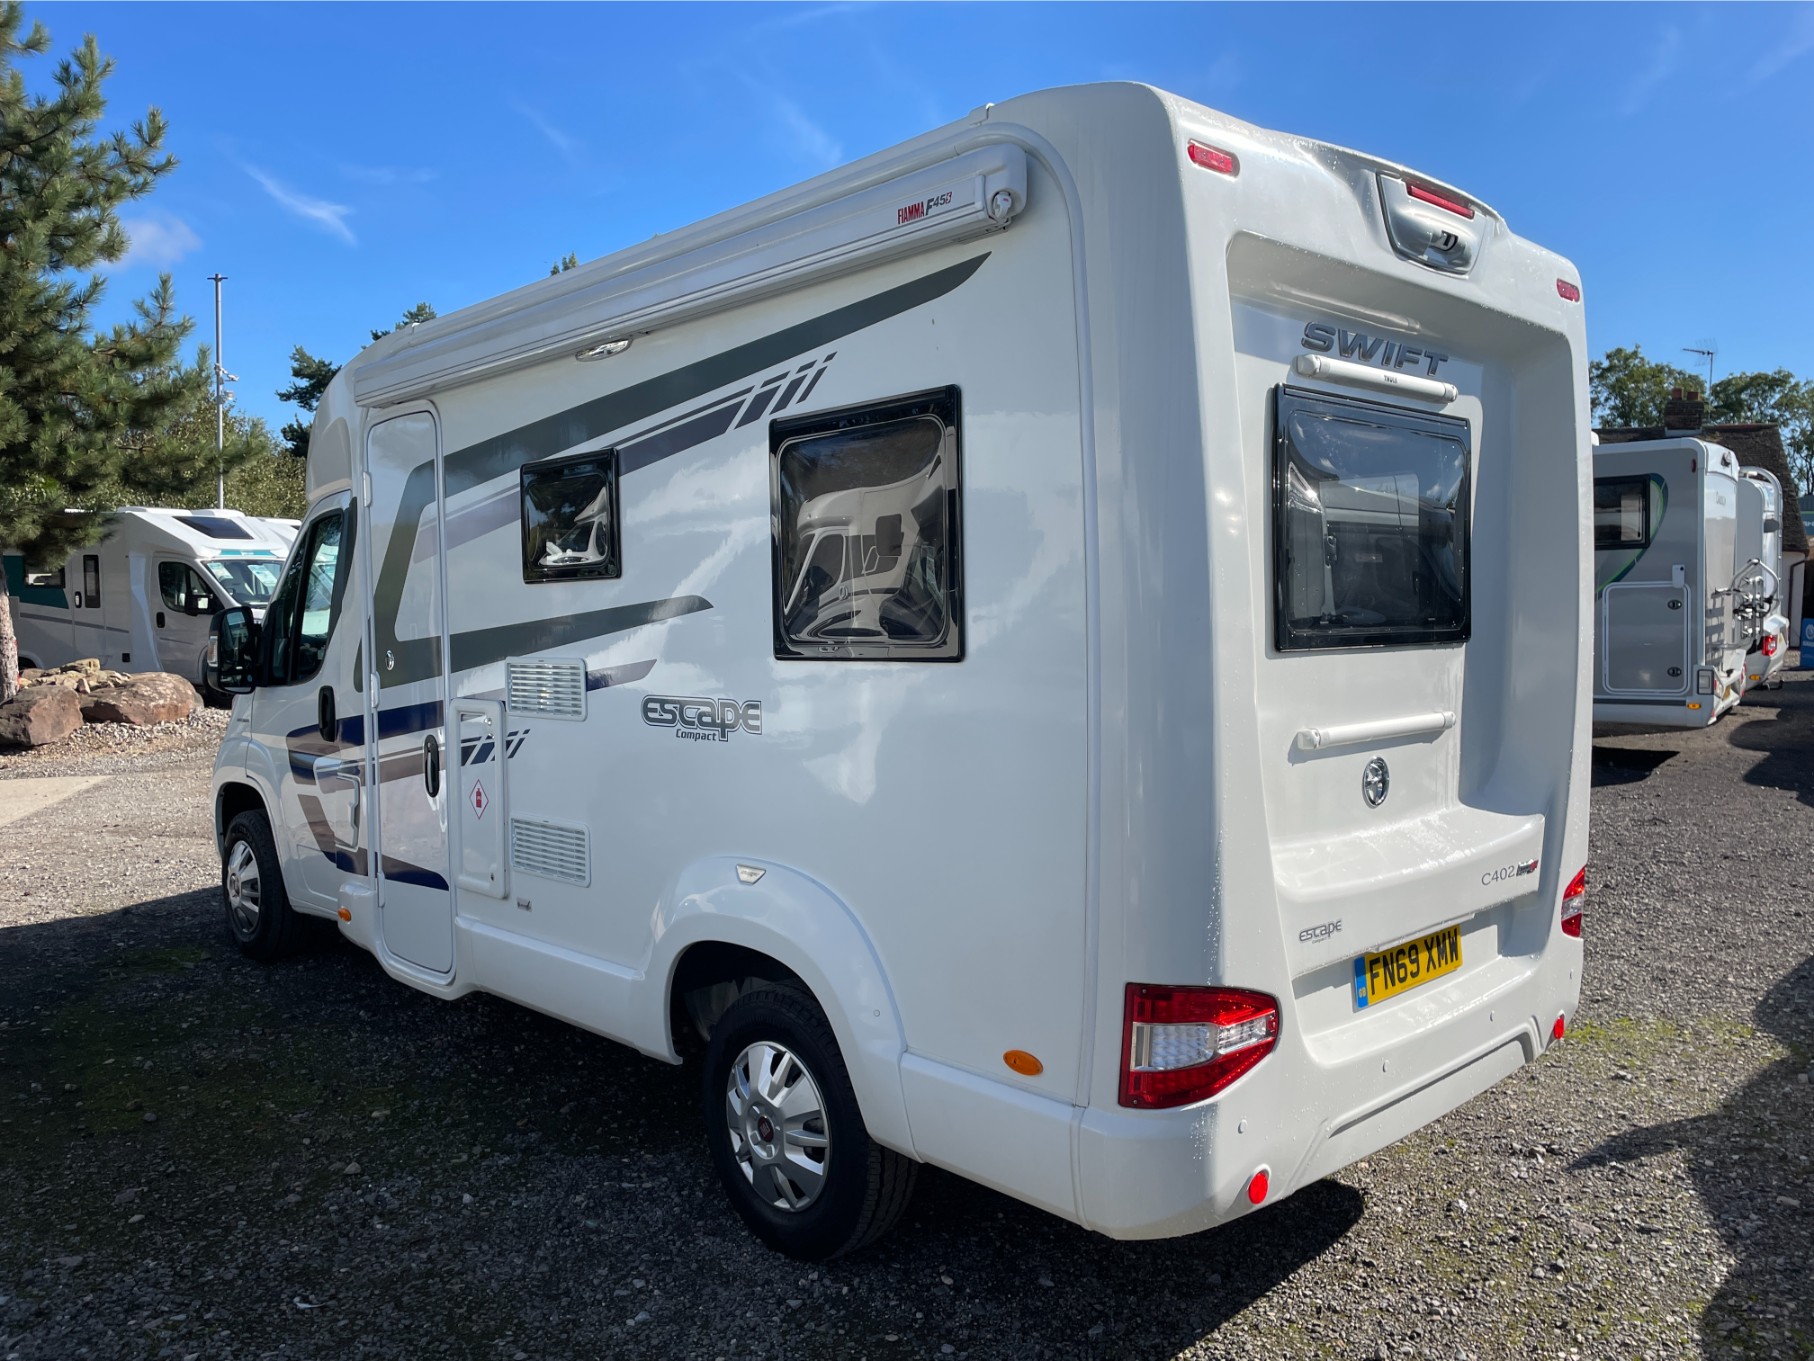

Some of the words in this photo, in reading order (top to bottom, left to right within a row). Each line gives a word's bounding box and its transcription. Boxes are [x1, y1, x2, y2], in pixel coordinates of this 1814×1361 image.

[898, 201, 925, 225] FIAMMA
[1301, 321, 1449, 377] SWIFT
[676, 728, 717, 742] Compact
[1481, 865, 1515, 886] C402
[1369, 943, 1421, 996] FN69
[1424, 927, 1459, 973] XMW
